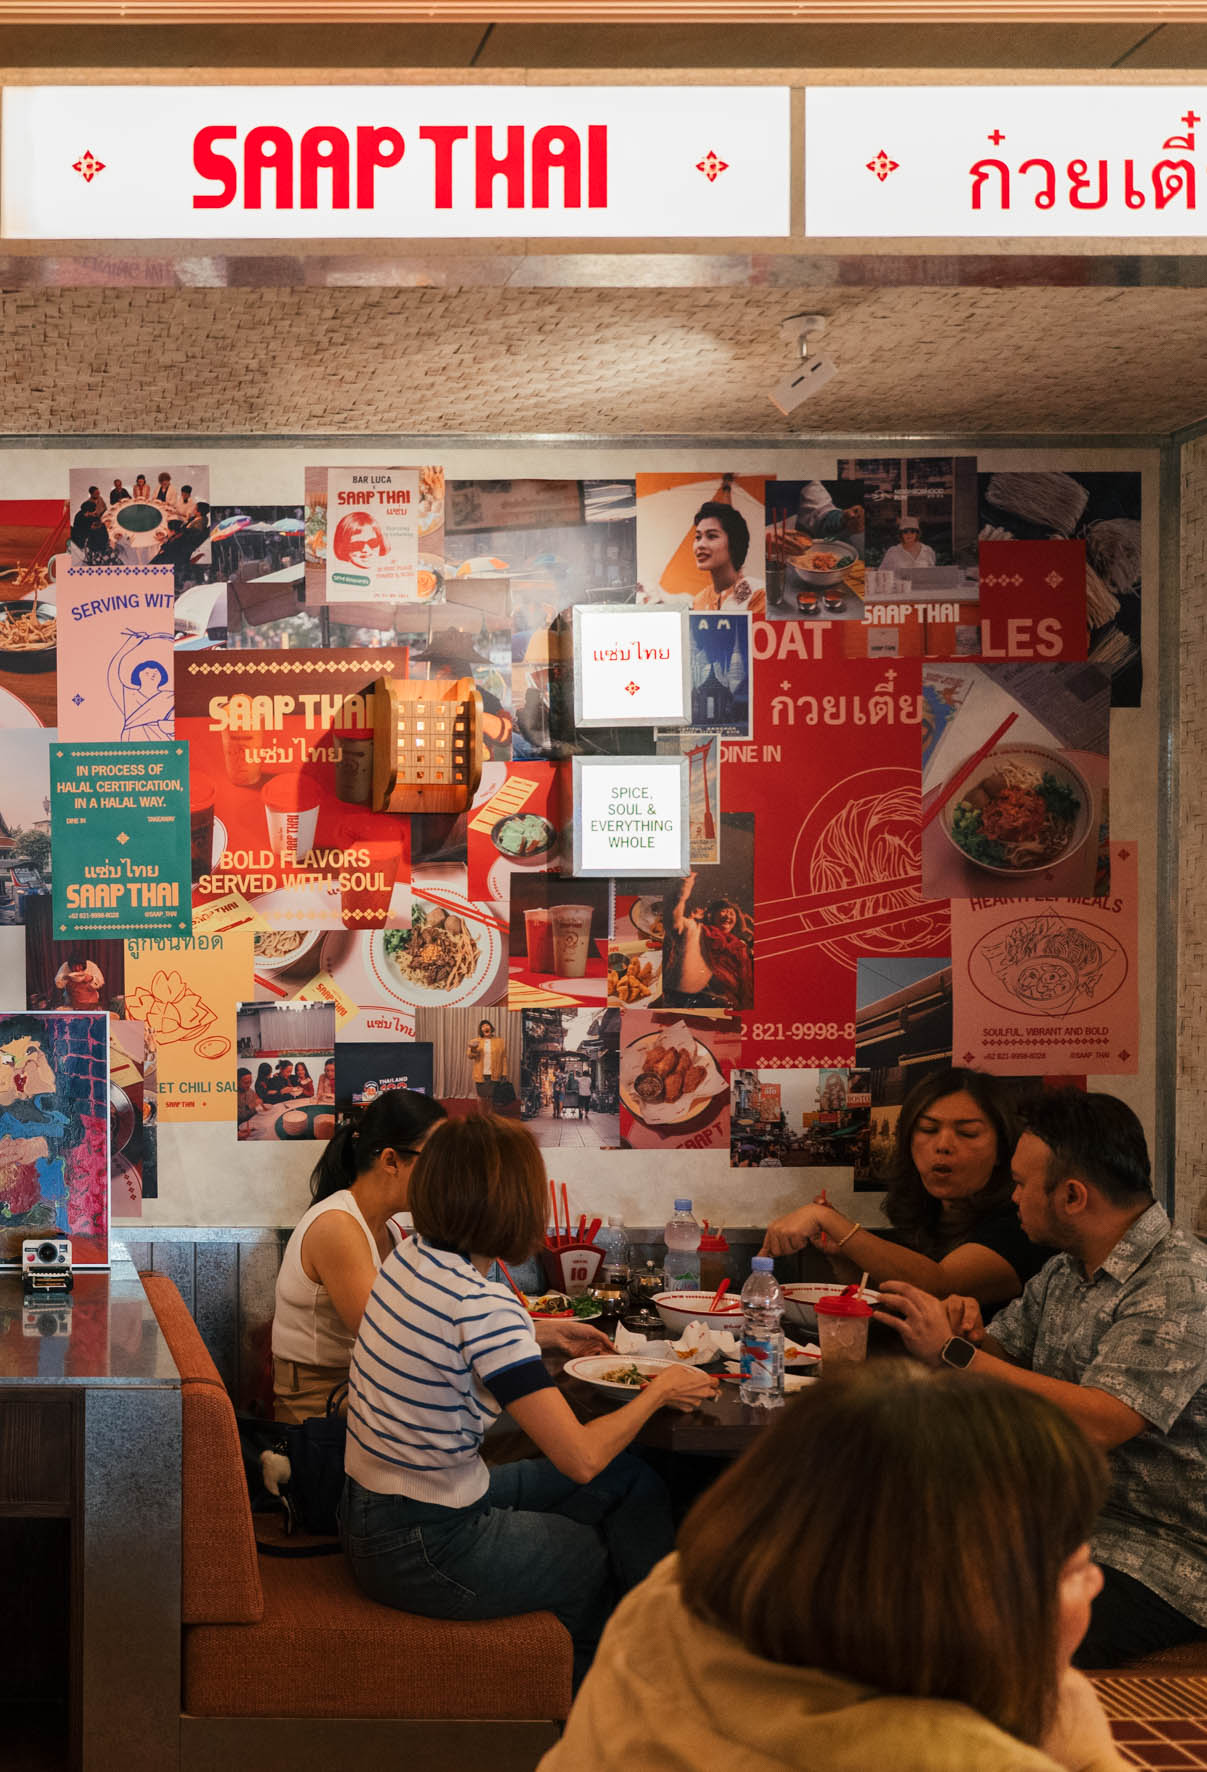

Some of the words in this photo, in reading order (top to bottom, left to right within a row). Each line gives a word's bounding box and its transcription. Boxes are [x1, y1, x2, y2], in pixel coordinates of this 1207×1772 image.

[192, 125, 406, 209] SAAP
[419, 125, 607, 208] THAI
[968, 110, 1205, 210] ก๋วยเตี๋
[352, 476, 368, 484] BAR
[371, 475, 392, 484] LUCA
[337, 491, 375, 505] SAAP
[376, 490, 411, 504] THAI
[71, 593, 140, 622] SERVING
[145, 592, 174, 610] WIT
[861, 605, 913, 625] SAAP
[914, 602, 960, 624] THAI
[752, 620, 832, 660] OAT
[208, 694, 295, 732] SAAP
[299, 693, 375, 730] THAI
[763, 745, 781, 762] IN
[76, 765, 89, 776] IN
[91, 764, 145, 776] PROCESS
[148, 764, 164, 775] OF
[56, 782, 93, 793] HALAL
[96, 780, 184, 793] CERTIFICATION,
[611, 787, 653, 801] SPICE,
[74, 798, 87, 808] IN
[89, 798, 98, 808] A
[100, 797, 137, 808] HALAL
[139, 796, 167, 808] WAY.
[608, 803, 642, 816] SOUL
[647, 803, 657, 815] &
[591, 820, 673, 832] EVERYTHING
[608, 836, 655, 849] WHOLE
[220, 851, 274, 870] BOLD
[280, 849, 370, 870] FLAVORS
[199, 874, 277, 894] SERVED
[282, 873, 332, 893] WITH
[339, 872, 391, 892] SOUL
[66, 884, 125, 909] SAAP
[127, 882, 179, 908] THAI
[315, 983, 335, 1001] SAAP
[752, 1022, 855, 1041] 821-9998-8
[1026, 1027, 1063, 1036] VIBRANT
[1064, 1027, 1083, 1035] AND
[1085, 1026, 1109, 1035] BOLD
[179, 1081, 211, 1093] CHILI
